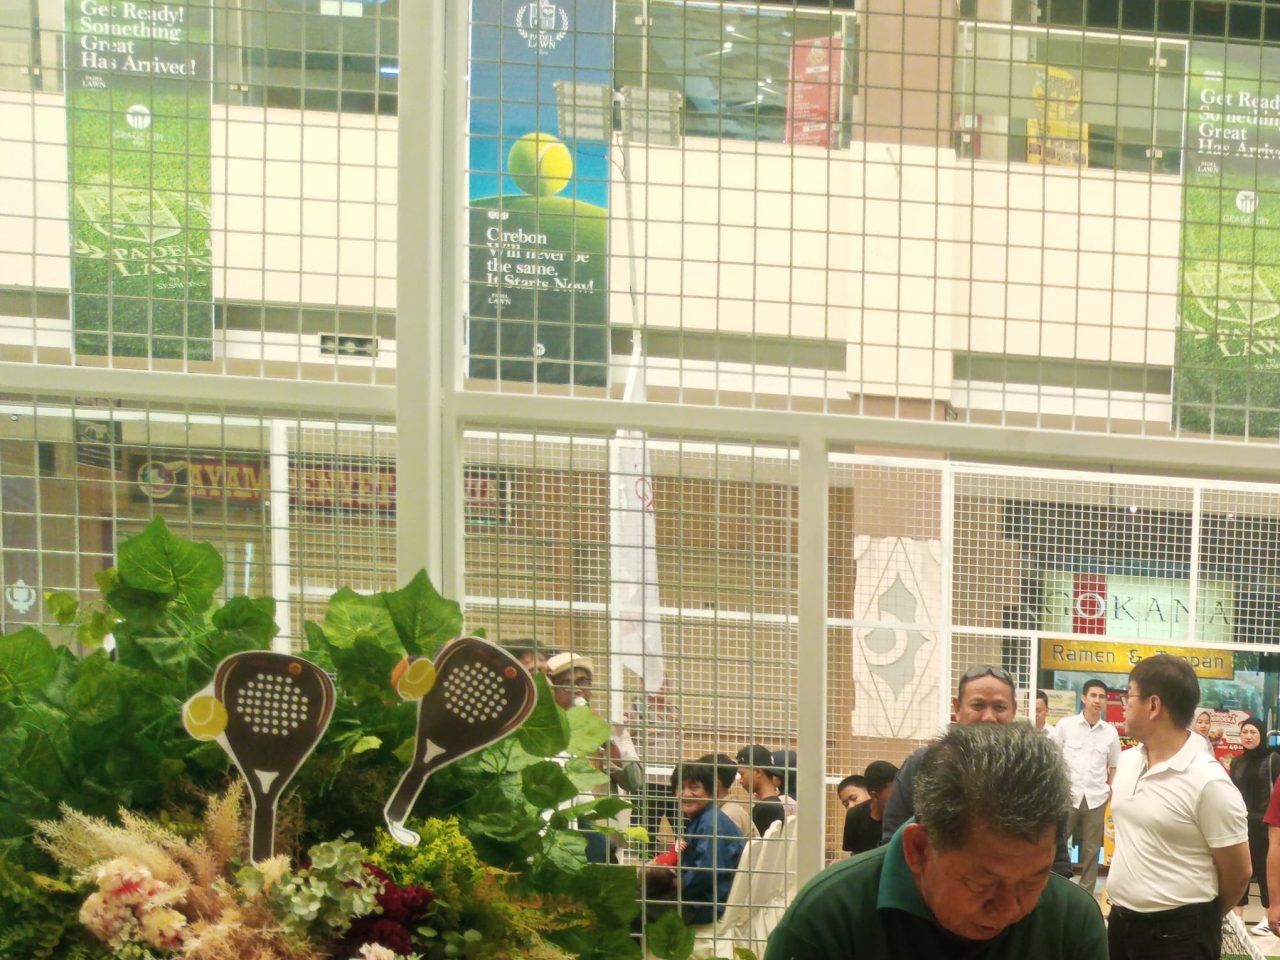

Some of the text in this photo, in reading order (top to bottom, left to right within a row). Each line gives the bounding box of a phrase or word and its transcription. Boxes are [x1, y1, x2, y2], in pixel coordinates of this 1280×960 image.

[80, 0, 184, 27] Get Ready!
[80, 16, 182, 45] Something
[529, 34, 554, 42] PADEL
[80, 35, 135, 54] Great
[528, 41, 556, 49] LAWN
[80, 51, 196, 75] Has Arrived!
[82, 80, 106, 88] LAWN
[1200, 88, 1233, 106] Get
[1198, 122, 1248, 141] Great
[1197, 138, 1230, 156] Has
[487, 257, 558, 277] the same.
[487, 273, 594, 294] It Starts Now!
[186, 462, 273, 500] AYAM
[1044, 590, 1231, 625] GOKANA
[1052, 644, 1115, 664] Ramen
[1129, 648, 1143, 664] &
